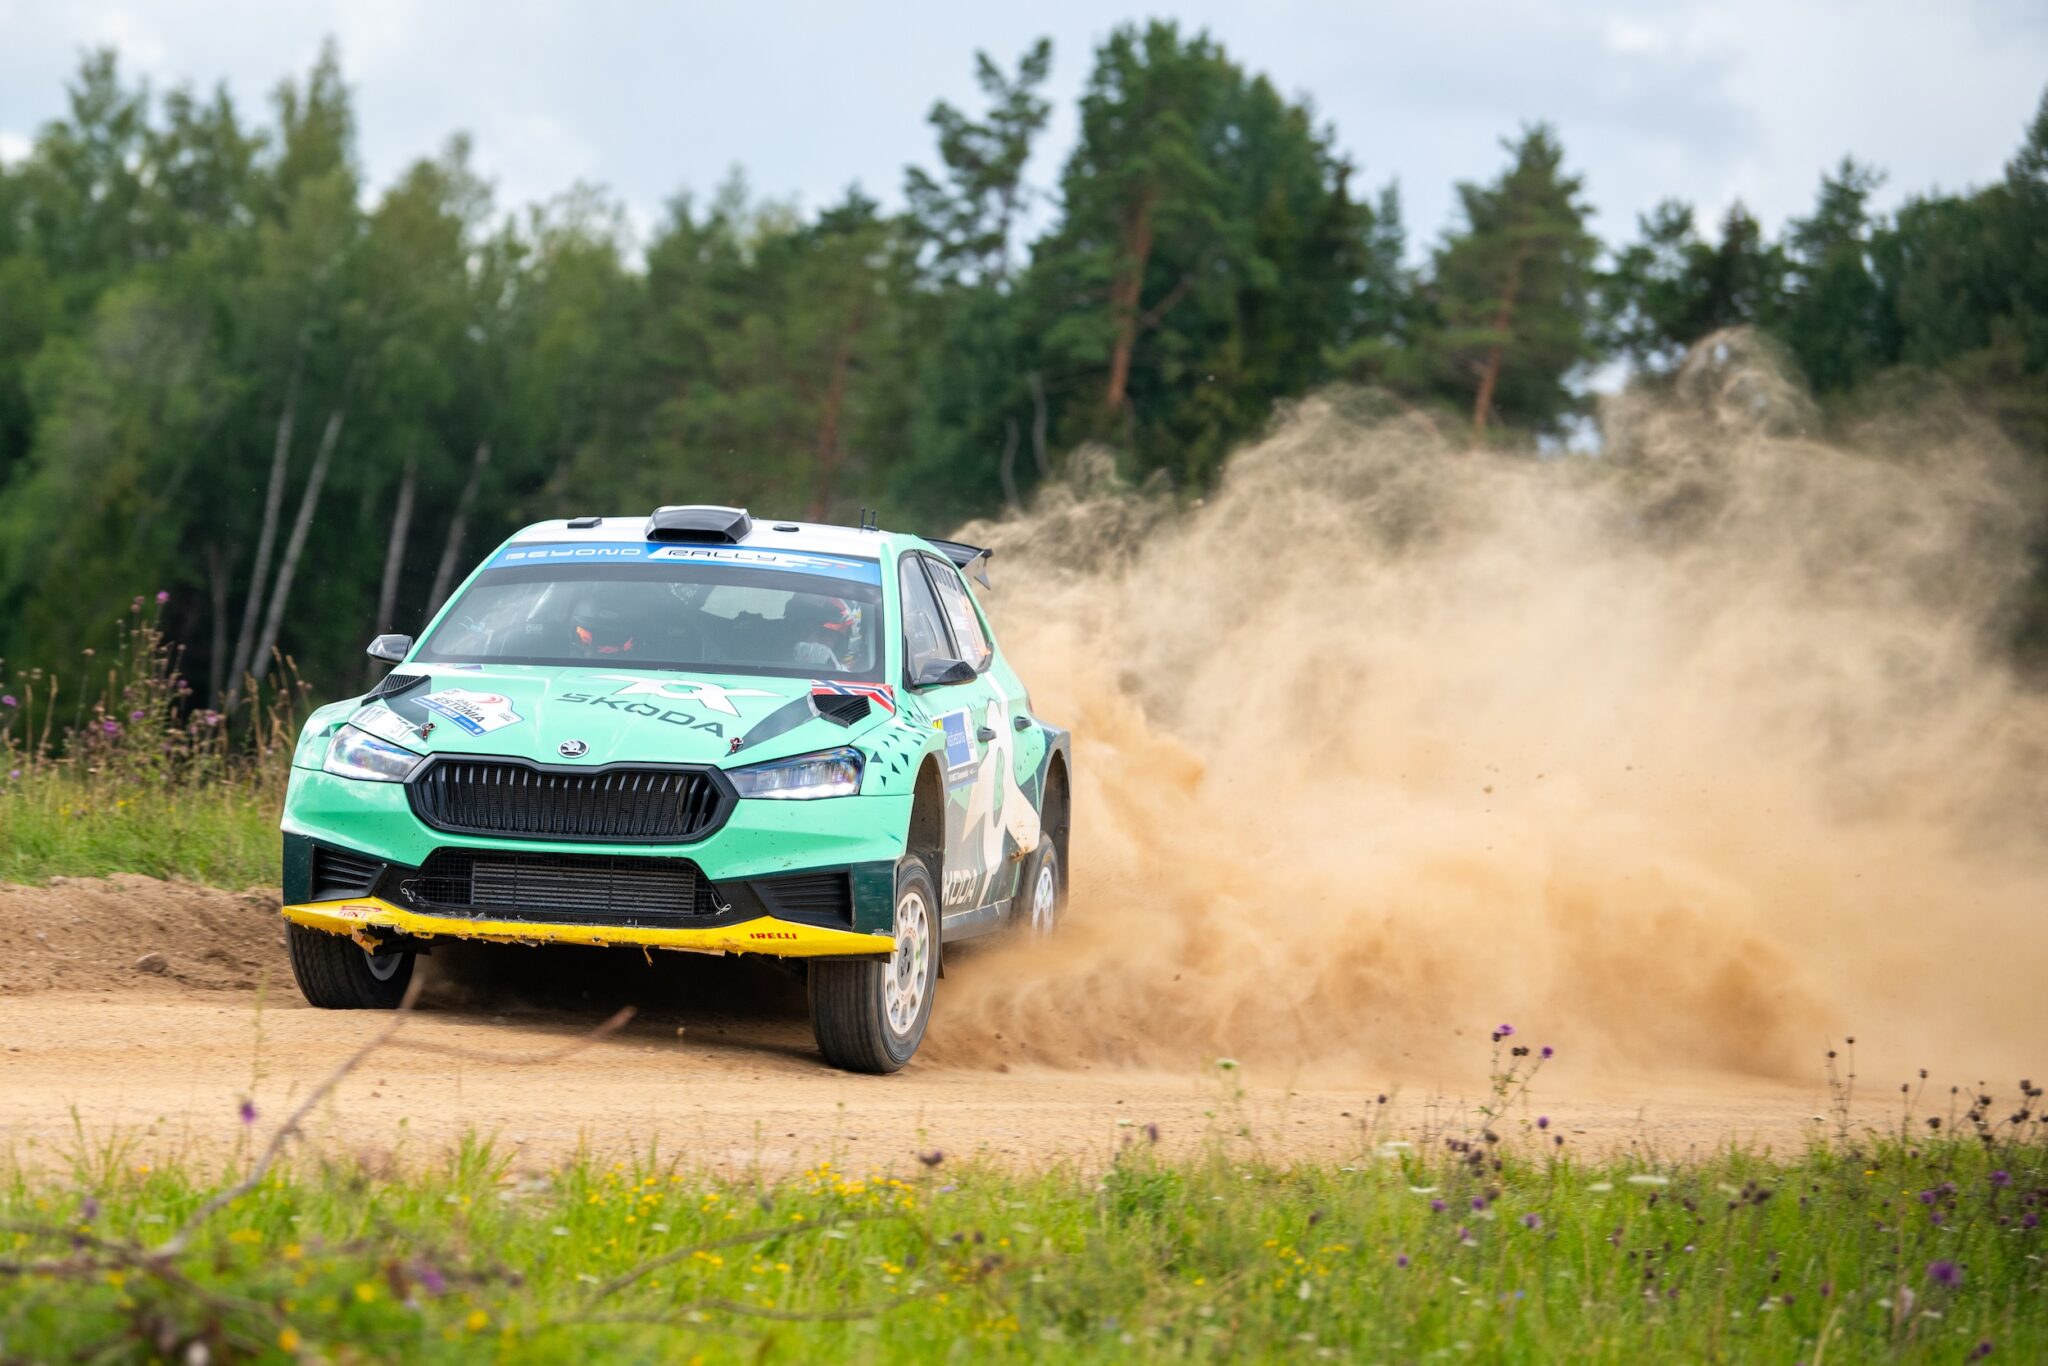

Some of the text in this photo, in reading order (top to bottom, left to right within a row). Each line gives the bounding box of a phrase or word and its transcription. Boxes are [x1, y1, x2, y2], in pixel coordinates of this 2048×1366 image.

[505, 548, 777, 562] BEYOND RALLY
[433, 697, 486, 723] ESTONIA
[942, 868, 978, 906] KODA
